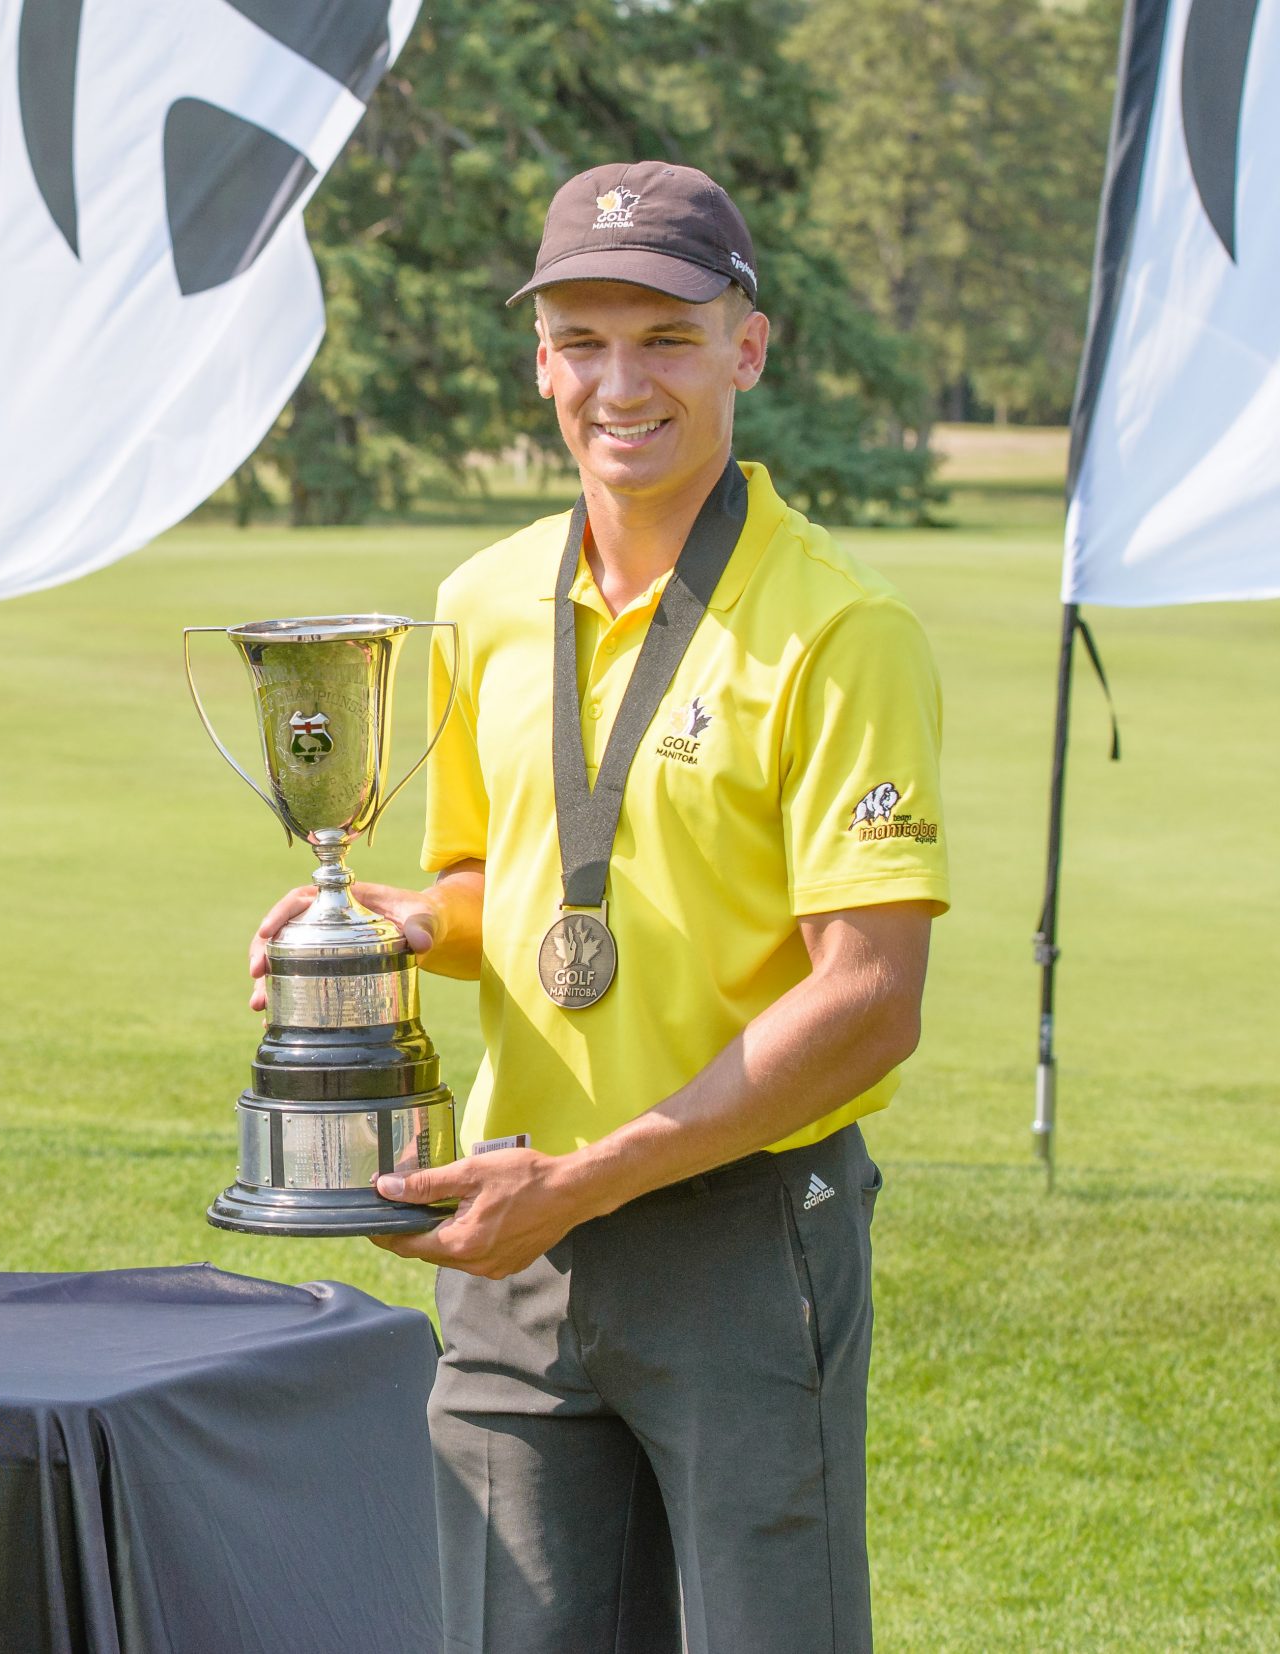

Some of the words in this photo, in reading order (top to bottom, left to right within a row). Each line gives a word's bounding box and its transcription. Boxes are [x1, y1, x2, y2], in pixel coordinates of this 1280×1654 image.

[592, 221, 634, 230] MANITOBA
[597, 212, 633, 222] GOLF
[663, 736, 701, 754] GOLF
[656, 748, 698, 765] MANITOBA
[859, 818, 937, 842] manitoba
[554, 969, 595, 986] GOLF
[549, 986, 597, 998] MANITOBA
[803, 1187, 835, 1210] adidas
